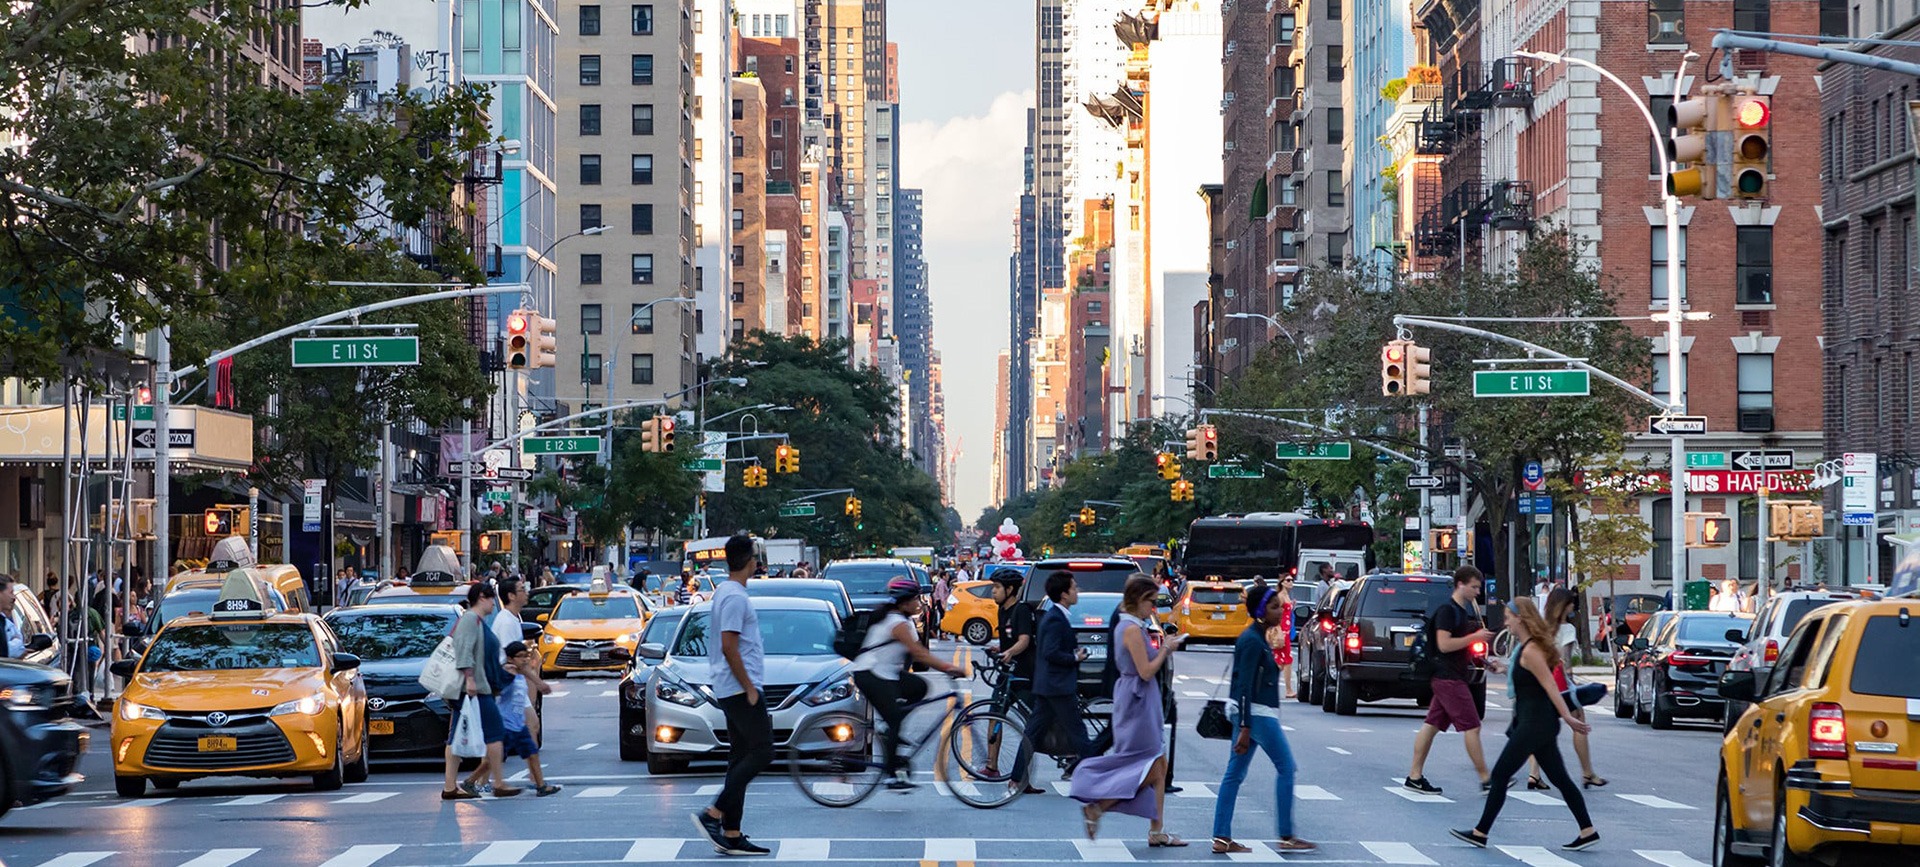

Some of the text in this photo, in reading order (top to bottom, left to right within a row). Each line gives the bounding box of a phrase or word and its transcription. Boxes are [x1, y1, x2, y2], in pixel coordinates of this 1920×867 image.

[333, 343, 378, 359] E 11 St
[1510, 375, 1552, 390] E 11 St
[118, 407, 124, 419] E
[1660, 422, 1700, 430] ONE WAY
[144, 434, 188, 443] ON WAY
[545, 440, 577, 451] E 12 St
[1319, 445, 1328, 456] St
[1691, 454, 1698, 465] E
[1701, 454, 1708, 465] 11
[1743, 456, 1787, 465] ONE WAY
[1727, 473, 1814, 491] HARDWA
[425, 572, 441, 582] 7C47
[226, 600, 249, 611] 8H94
